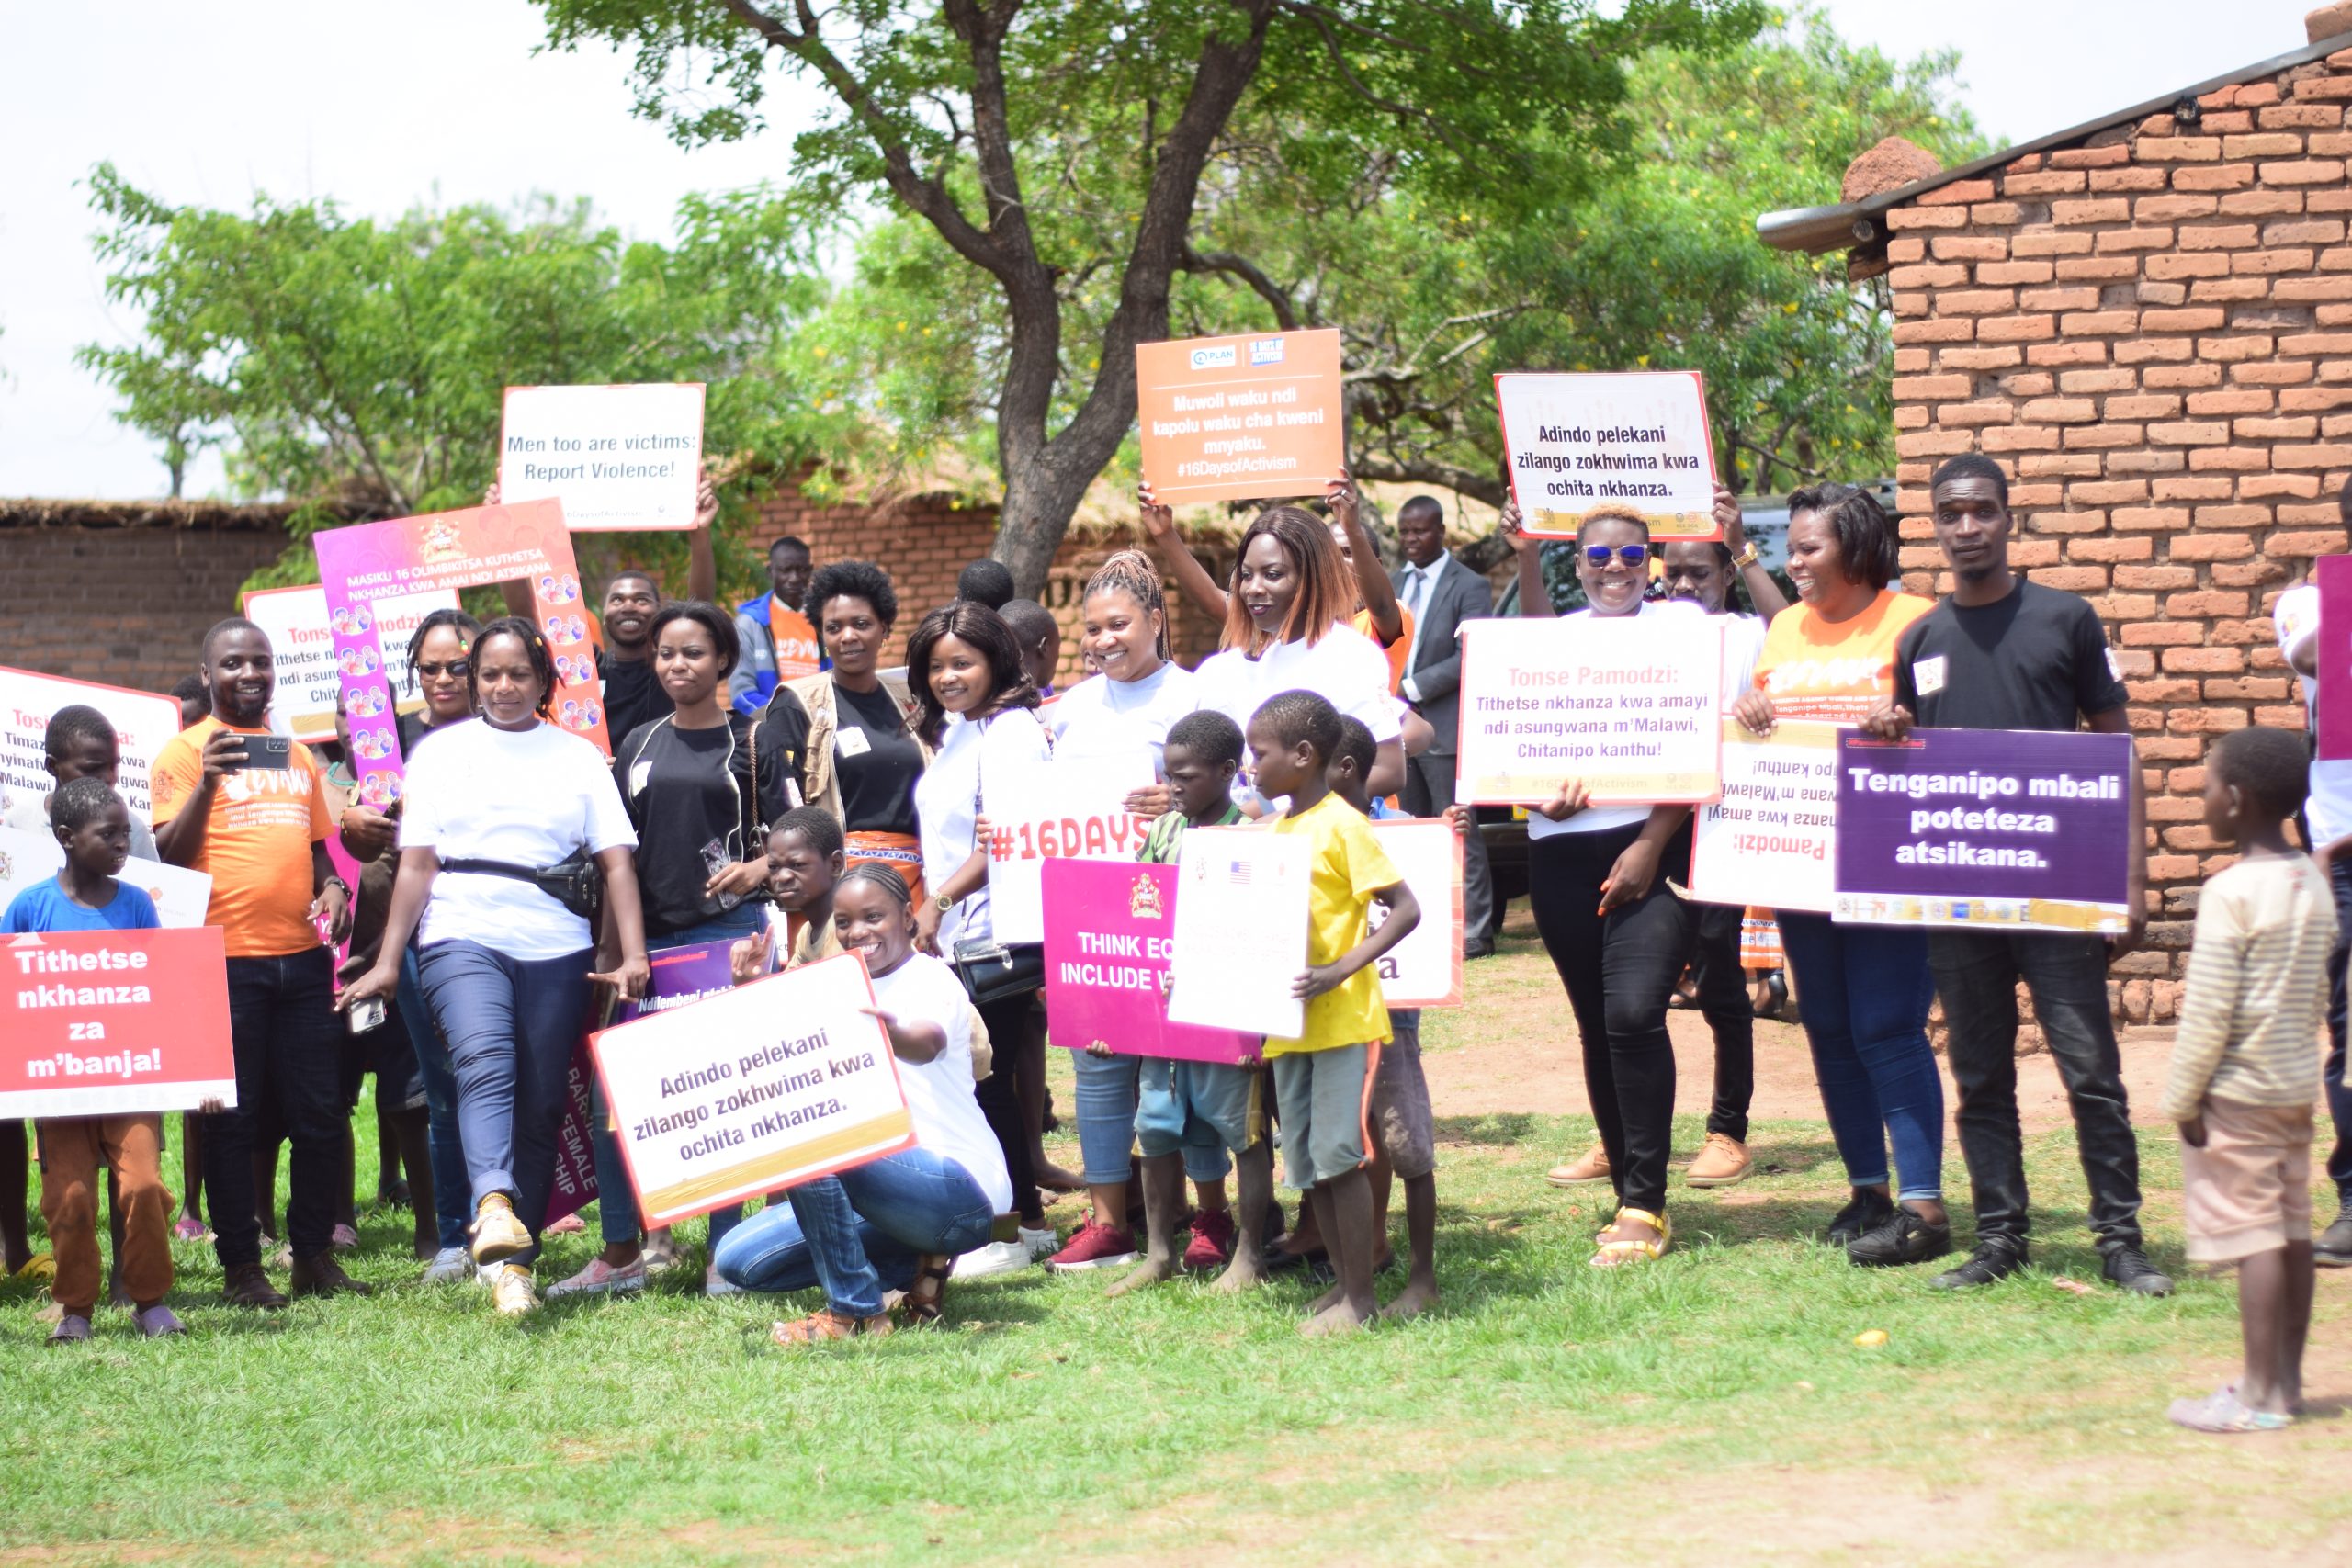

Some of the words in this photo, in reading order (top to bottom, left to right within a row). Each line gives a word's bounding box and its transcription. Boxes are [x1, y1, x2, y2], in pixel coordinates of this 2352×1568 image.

[1209, 351, 1233, 360] PLAN
[1173, 392, 1225, 412] Muwoli
[1228, 390, 1268, 408] waku
[1272, 387, 1296, 402] ndi
[1153, 418, 1199, 438] kapolu
[1203, 414, 1241, 432] waku
[1245, 412, 1272, 427] cha
[1277, 409, 1324, 425] kweni
[507, 436, 546, 452] Men
[553, 436, 581, 452] too
[588, 439, 617, 451] are
[625, 434, 695, 450] victims:
[1204, 436, 1266, 456] mnyaku.
[1539, 425, 1591, 443] Adindo
[1597, 425, 1666, 446] pelekani
[524, 463, 584, 483] Report
[591, 461, 674, 479] Violence!
[1178, 457, 1296, 477] #16DaysofActivism
[1517, 451, 1571, 473] zilango
[1576, 453, 1657, 470] zokhwima
[1663, 453, 1699, 469] kwa
[1547, 479, 1594, 497] ochita
[1599, 480, 1673, 497] nkhanza.
[347, 573, 392, 588] MASIKU
[395, 569, 410, 581] 16
[411, 558, 483, 579] OLIMBIKITSA
[485, 548, 544, 567] KUTHETSA
[347, 584, 407, 601] NKHANZA
[409, 580, 435, 594] KWA
[470, 572, 493, 587] NDI
[495, 562, 552, 581] ATSIKANA
[279, 671, 300, 686] ndi
[1508, 668, 1569, 687] Tonse
[1577, 665, 1678, 686] Pamodzi:
[1476, 696, 1539, 711] Tithetse
[1545, 695, 1613, 710] nkhanza
[1620, 694, 1653, 708] kwa
[1659, 694, 1708, 711] amayi
[1484, 720, 1509, 735] ndi
[1514, 720, 1608, 737] asungwana
[5, 731, 46, 750] Timaz
[1517, 743, 1594, 760] Chitanipo
[1600, 741, 1662, 758] kanthu!
[1848, 767, 2019, 800] Tenganipo
[2028, 774, 2120, 799] mbali
[1707, 805, 1753, 821] amayi
[1758, 810, 1789, 827] kwa
[1910, 807, 2056, 833] poteteza
[1733, 833, 1826, 861] Pamodzi:
[1894, 841, 2047, 868] atsikana.
[1078, 931, 1141, 958] THINK
[14, 947, 148, 975] Tithetse
[1061, 963, 1152, 990] INCLUDE
[18, 984, 151, 1009] nkhanza
[69, 1021, 105, 1041] za
[28, 1048, 161, 1078] m'banja!
[660, 1061, 733, 1099] Adindo
[739, 1028, 830, 1077] pelekani
[633, 1104, 710, 1142] zilango
[715, 1066, 823, 1116] zokhwima
[828, 1052, 876, 1079] kwa
[679, 1127, 746, 1161] ochita
[751, 1097, 848, 1139] nkhanza.
